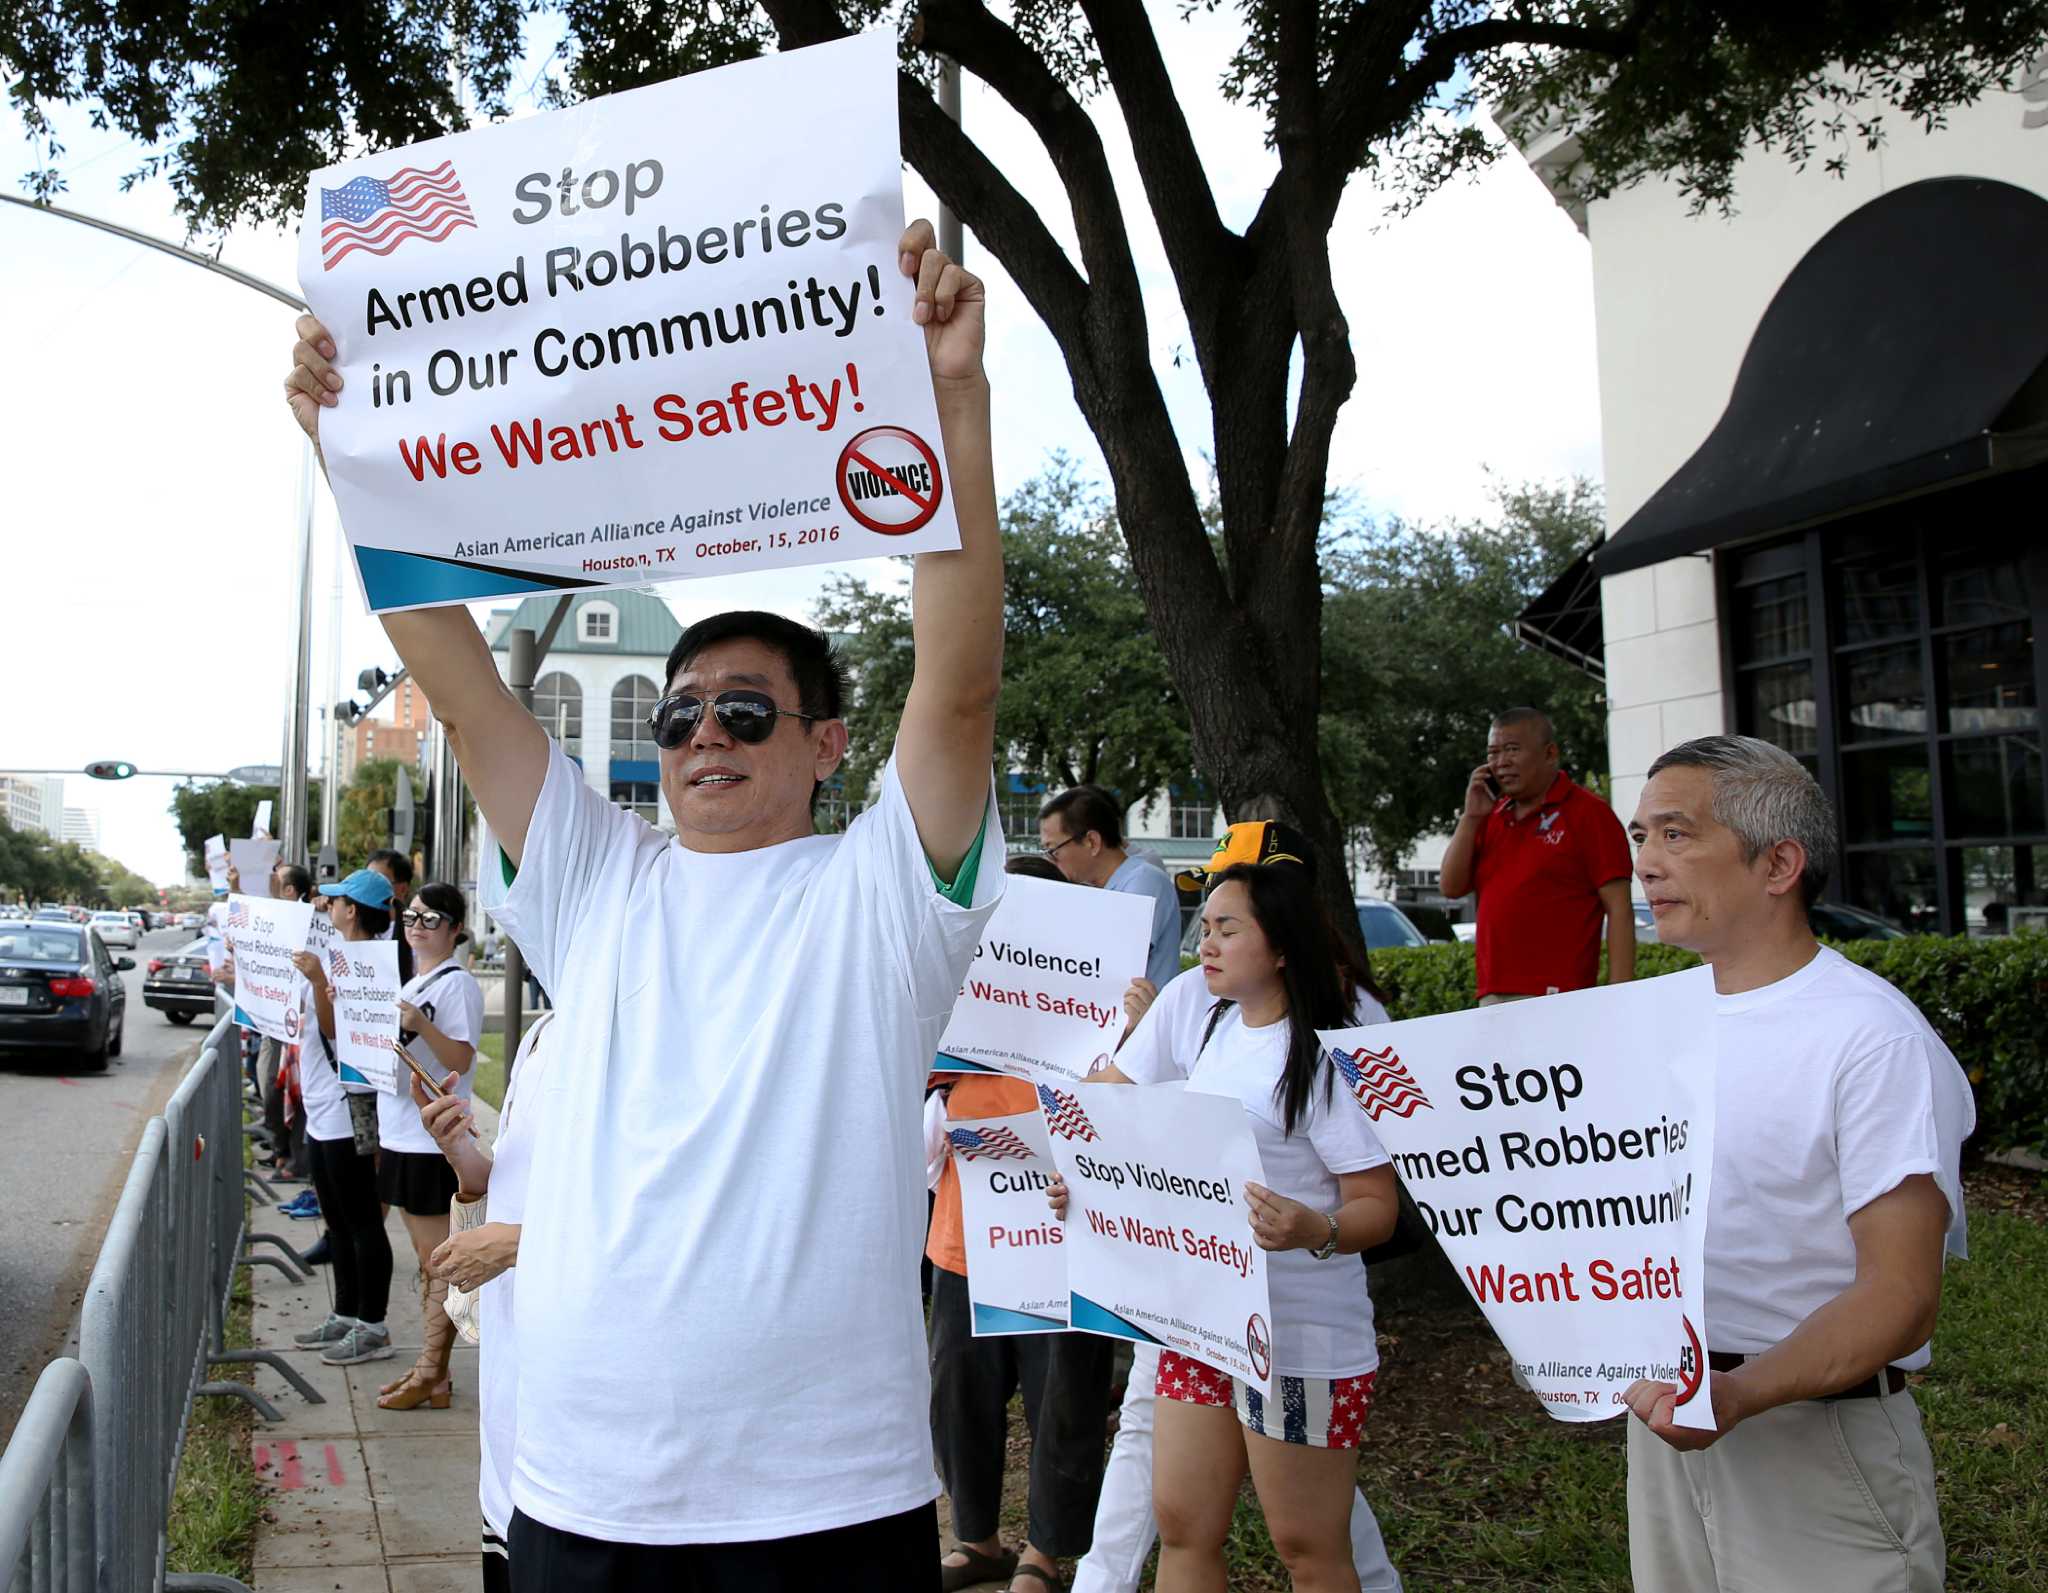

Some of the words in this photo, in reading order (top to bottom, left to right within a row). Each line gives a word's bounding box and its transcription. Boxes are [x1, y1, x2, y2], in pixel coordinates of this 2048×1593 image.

[513, 158, 664, 225] Stop
[366, 256, 528, 336] Armed
[546, 201, 847, 298] Robberies
[372, 363, 412, 408] in
[427, 346, 517, 398] Our
[533, 264, 886, 378] Community!
[399, 432, 483, 482] We
[491, 403, 644, 468] Want
[655, 362, 865, 438] Safety!
[848, 463, 931, 500] VIOLENCE
[454, 540, 500, 559] Asian
[504, 530, 586, 554] American
[591, 517, 665, 544] Alliance
[670, 507, 744, 534] Against
[747, 494, 831, 525] Violence
[583, 552, 652, 573] Houston,
[655, 546, 676, 564] TX
[695, 535, 762, 559] October,
[767, 531, 793, 554] 15,
[797, 525, 841, 547] 2016
[253, 915, 275, 938] Stop
[354, 960, 375, 981] Stop
[990, 940, 1101, 979] Violence!
[338, 985, 362, 1001] Armed
[363, 986, 396, 1002] Robberie
[970, 979, 1031, 1009] Want
[1036, 992, 1117, 1029] Safety!
[945, 1045, 968, 1054] Asian
[971, 1047, 1008, 1058] American
[1010, 1052, 1039, 1065] Alliance
[1041, 1060, 1065, 1074] Against
[1455, 1062, 1584, 1112] Stop
[1391, 1135, 1490, 1180] rmed
[1499, 1114, 1689, 1171] Robberies
[1075, 1154, 1125, 1190] Stop
[1125, 1161, 1234, 1206] Violence!
[989, 1222, 1064, 1249] Punis
[1085, 1208, 1119, 1239] We
[1120, 1215, 1180, 1252] Want
[1182, 1228, 1254, 1279] Safety!
[1465, 1261, 1580, 1304] Want
[1588, 1255, 1682, 1302] Safet
[1019, 1300, 1045, 1311] Asian
[1047, 1299, 1068, 1309] Ame
[1114, 1304, 1134, 1315] Asian
[1136, 1309, 1168, 1325] American
[1170, 1317, 1197, 1334] Alliance
[1198, 1326, 1223, 1344] Against
[1223, 1335, 1249, 1357] Violence
[1537, 1360, 1592, 1378] Alliance
[1596, 1362, 1647, 1382] Against
[1650, 1362, 1680, 1381] Violen
[1584, 1391, 1600, 1405] TX
